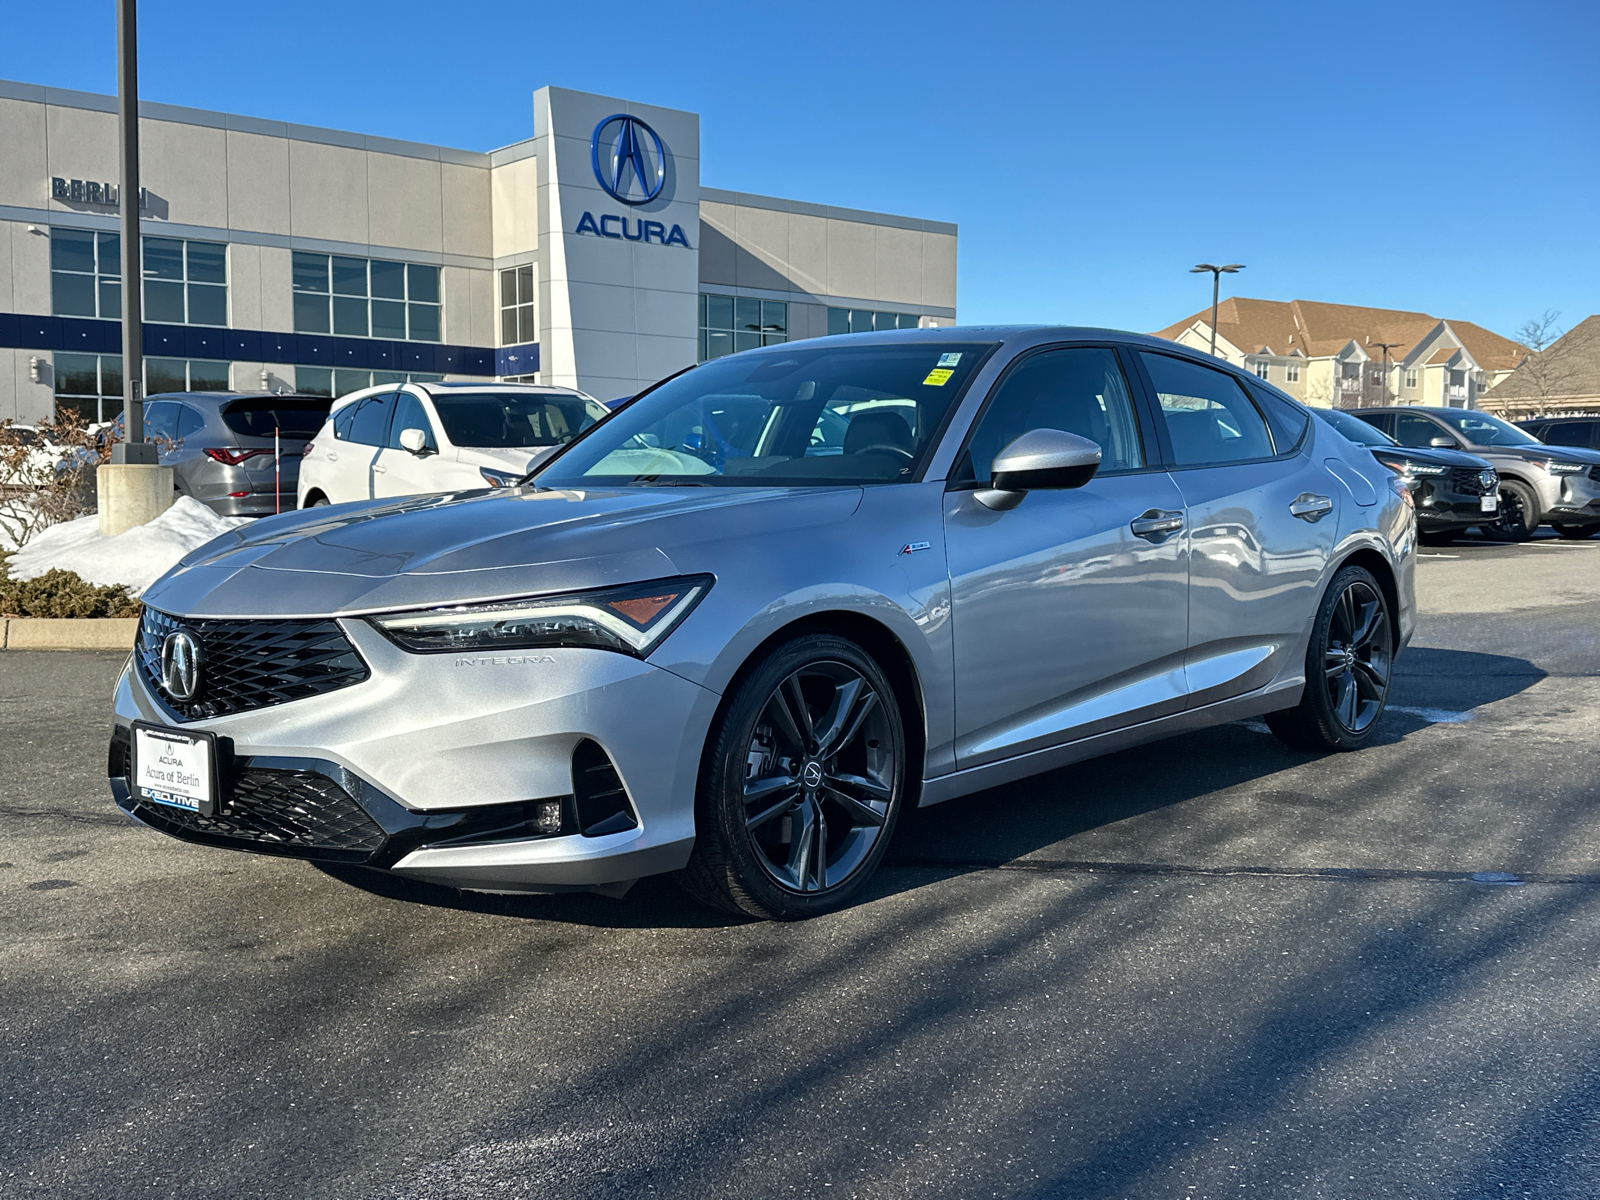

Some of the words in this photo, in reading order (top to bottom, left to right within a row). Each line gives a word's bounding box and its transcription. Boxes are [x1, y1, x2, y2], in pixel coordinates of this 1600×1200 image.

[575, 211, 690, 248] ACURA
[455, 655, 556, 667] INTEGRA
[158, 756, 183, 767] ACURA
[145, 765, 166, 781] Acura
[166, 772, 175, 782] of
[176, 773, 200, 788] Berlin
[141, 787, 199, 808] EXECUTIVE
